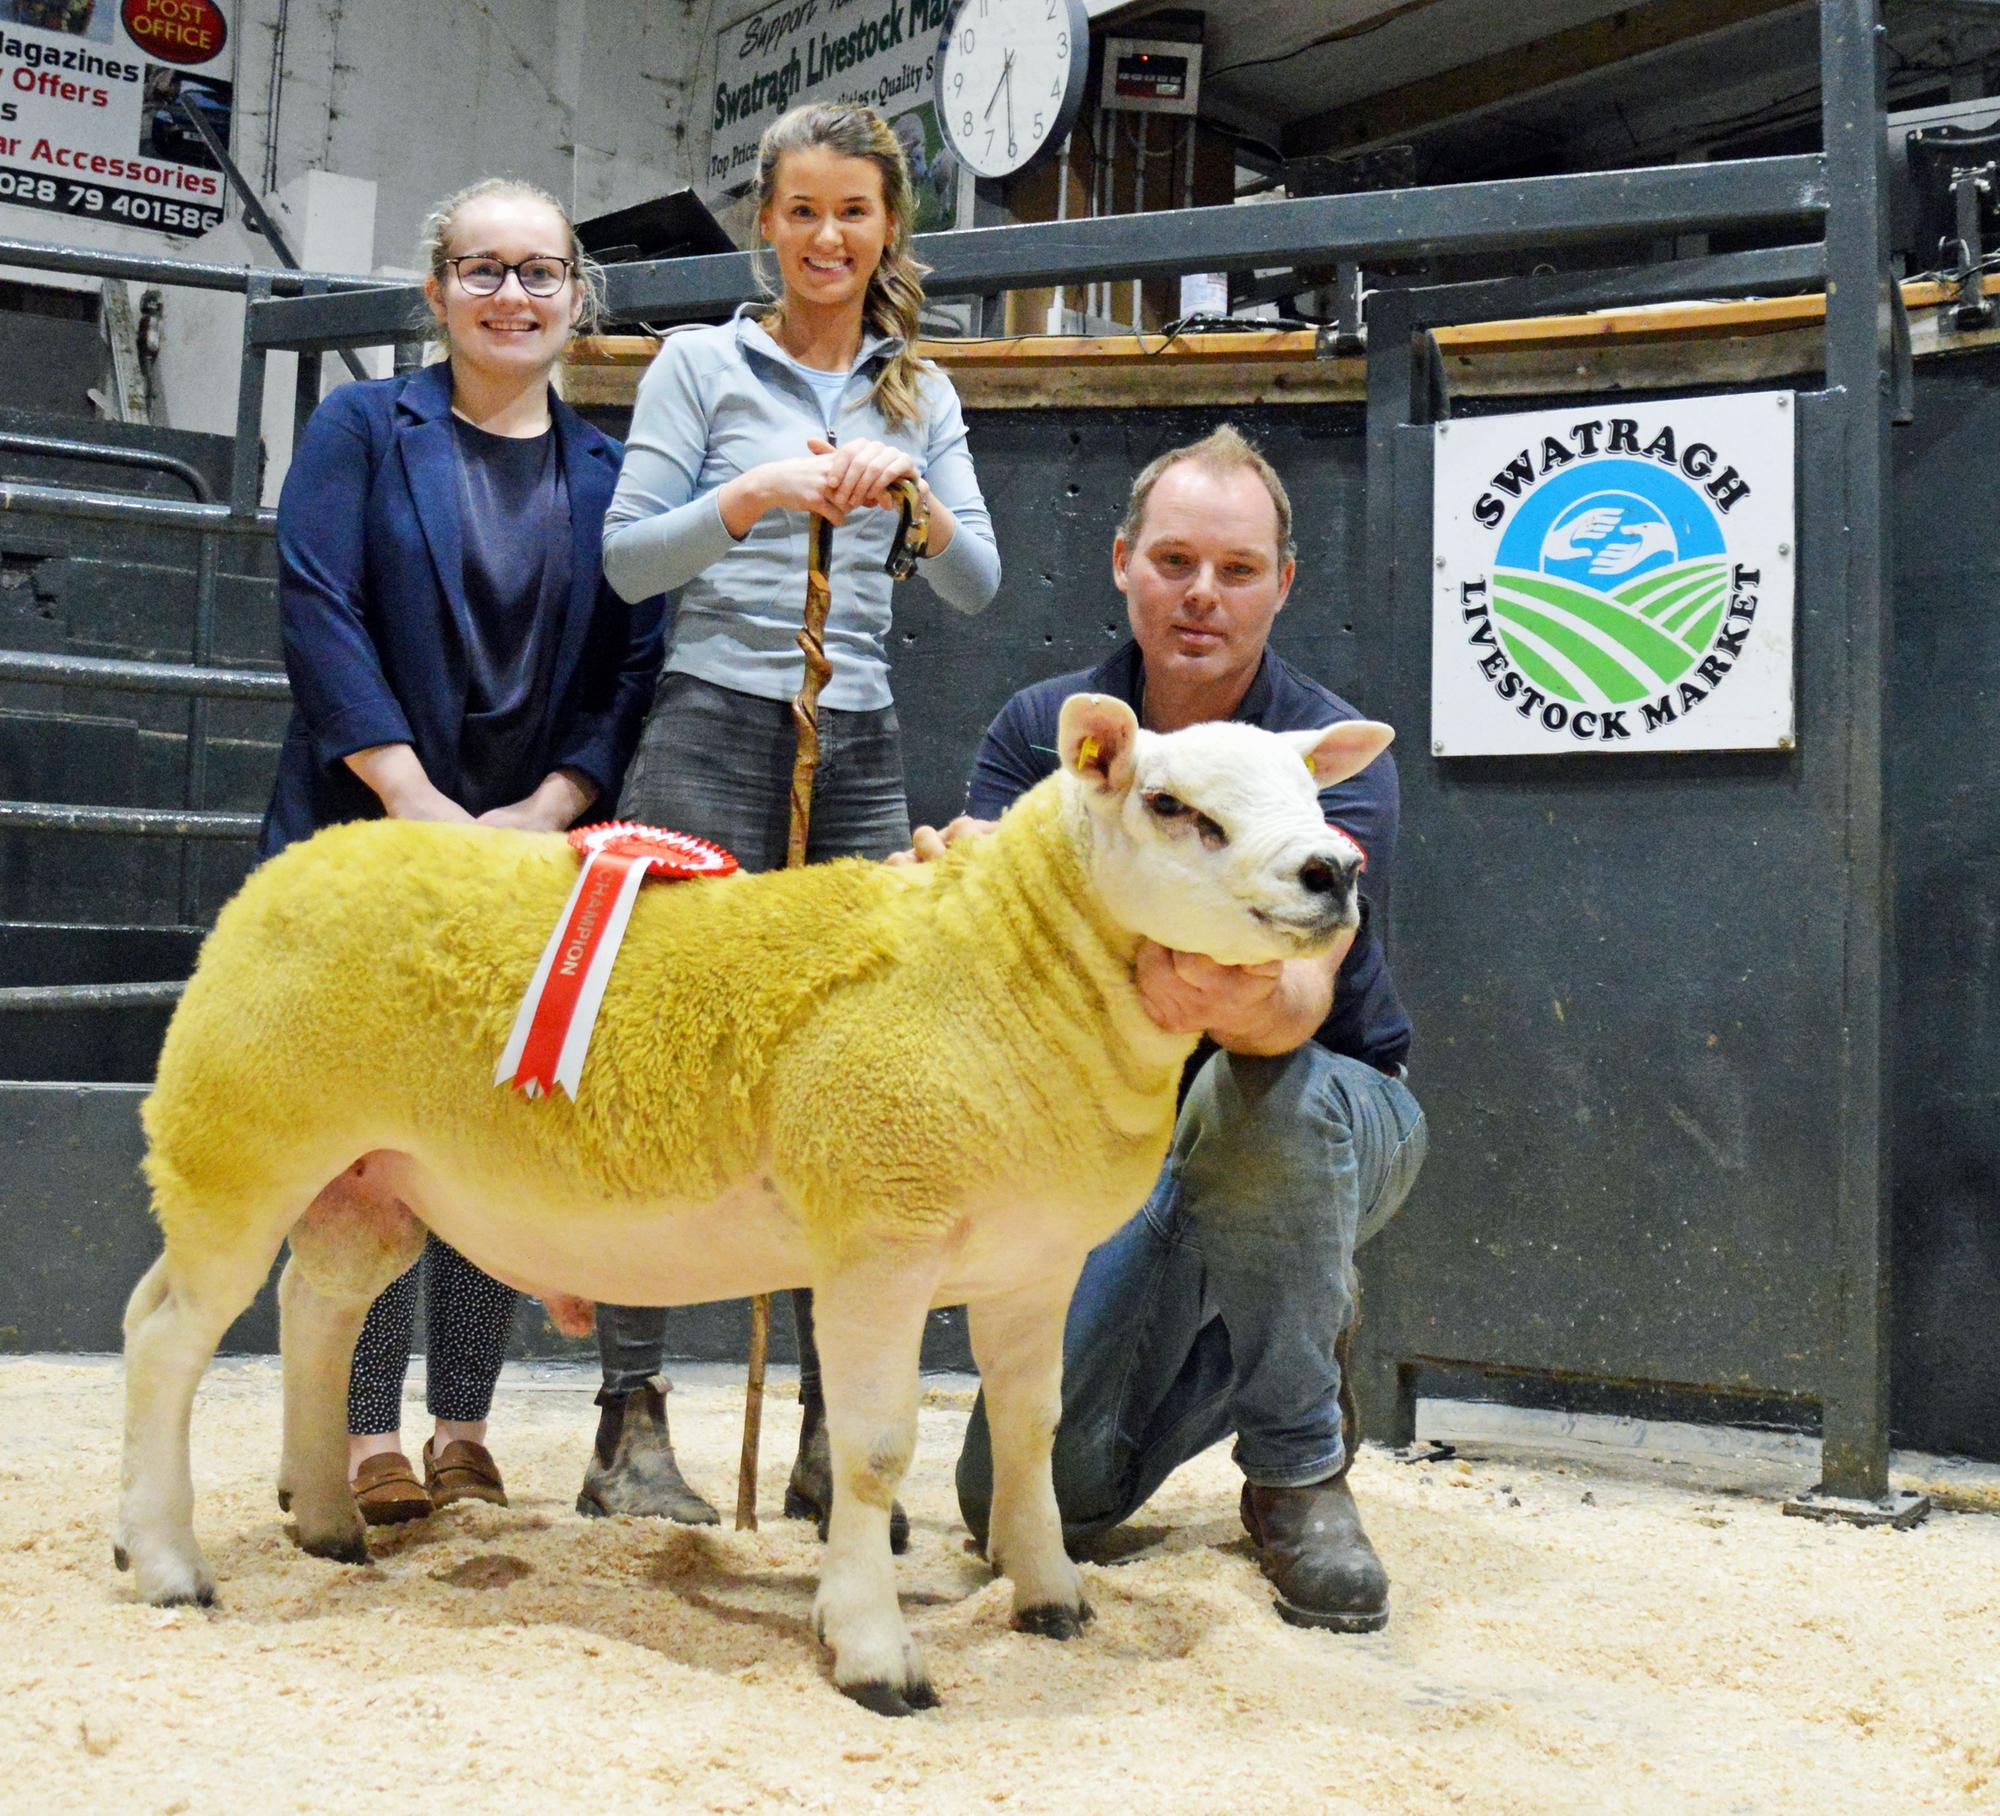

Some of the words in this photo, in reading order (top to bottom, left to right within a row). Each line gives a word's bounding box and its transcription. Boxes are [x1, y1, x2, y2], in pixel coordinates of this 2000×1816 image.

[146, 0, 207, 26] POST
[739, 0, 818, 59] Support
[132, 15, 213, 50] OFFICE
[958, 28, 975, 56] 10
[1056, 31, 1069, 59] 3
[0, 31, 140, 83] agazines
[714, 46, 801, 131] Swatragh
[806, 0, 904, 88] Livestock
[908, 0, 949, 38] Ma
[12, 67, 109, 108] Offers
[953, 72, 964, 99] 9
[1050, 74, 1062, 101] 4
[711, 154, 729, 180] Top
[879, 64, 923, 106] Quality
[962, 111, 974, 138] 8
[1032, 112, 1044, 140] 5
[984, 129, 995, 157] 7
[1008, 132, 1018, 159] 6
[30, 138, 218, 196] Accessories
[0, 172, 57, 202] 028
[67, 185, 104, 211] 79
[111, 195, 219, 231] 401586
[1472, 418, 1752, 530] SWATRAGH
[1460, 576, 1632, 742] LIVESTOCK
[1639, 563, 1762, 734] MARKET
[559, 870, 612, 976] CHAMPION
